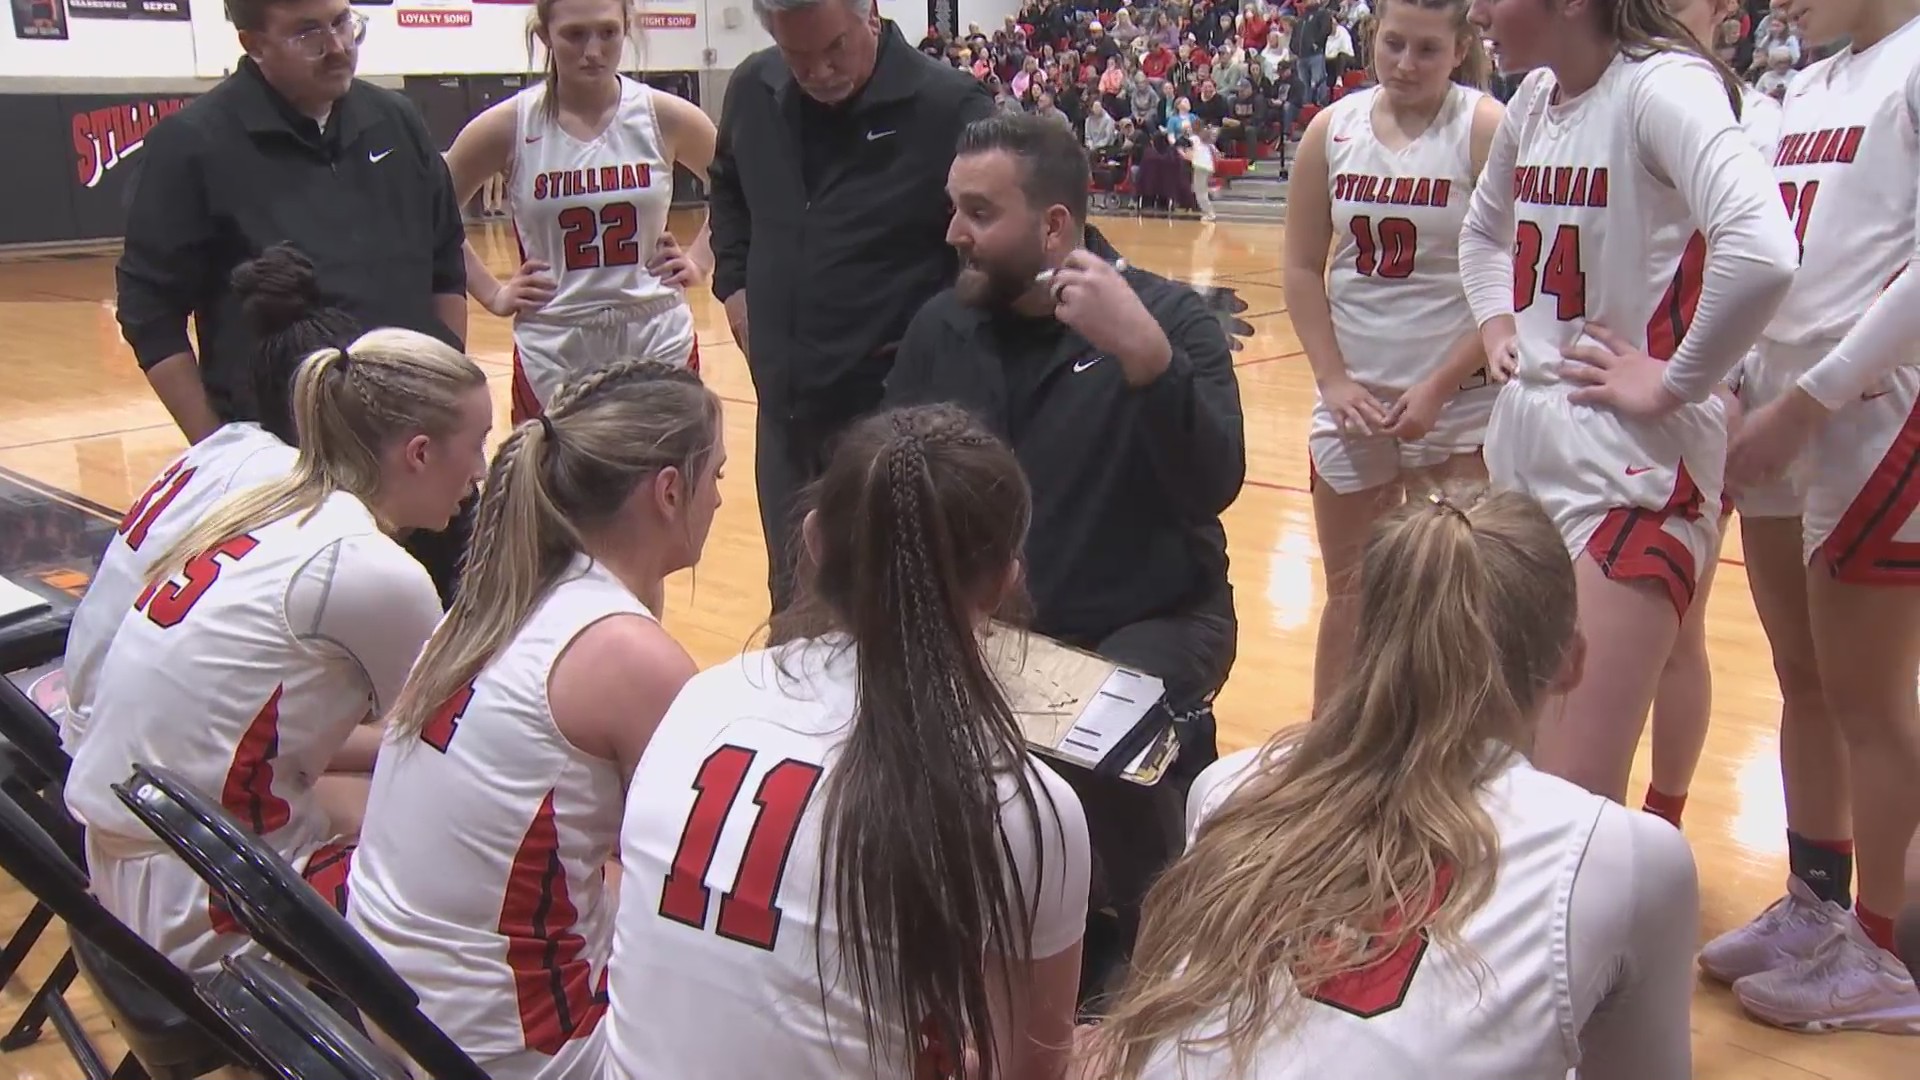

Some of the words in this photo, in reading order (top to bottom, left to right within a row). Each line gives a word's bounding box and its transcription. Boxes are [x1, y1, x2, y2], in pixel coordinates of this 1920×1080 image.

[400, 13, 441, 24] LOYALTY
[443, 14, 470, 24] SONG
[667, 16, 692, 26] SONG
[534, 163, 651, 200] STILLMAN
[1335, 173, 1452, 208] STILLMAN
[558, 201, 639, 271] 22
[1349, 214, 1417, 278] 10
[658, 743, 824, 952] 11
